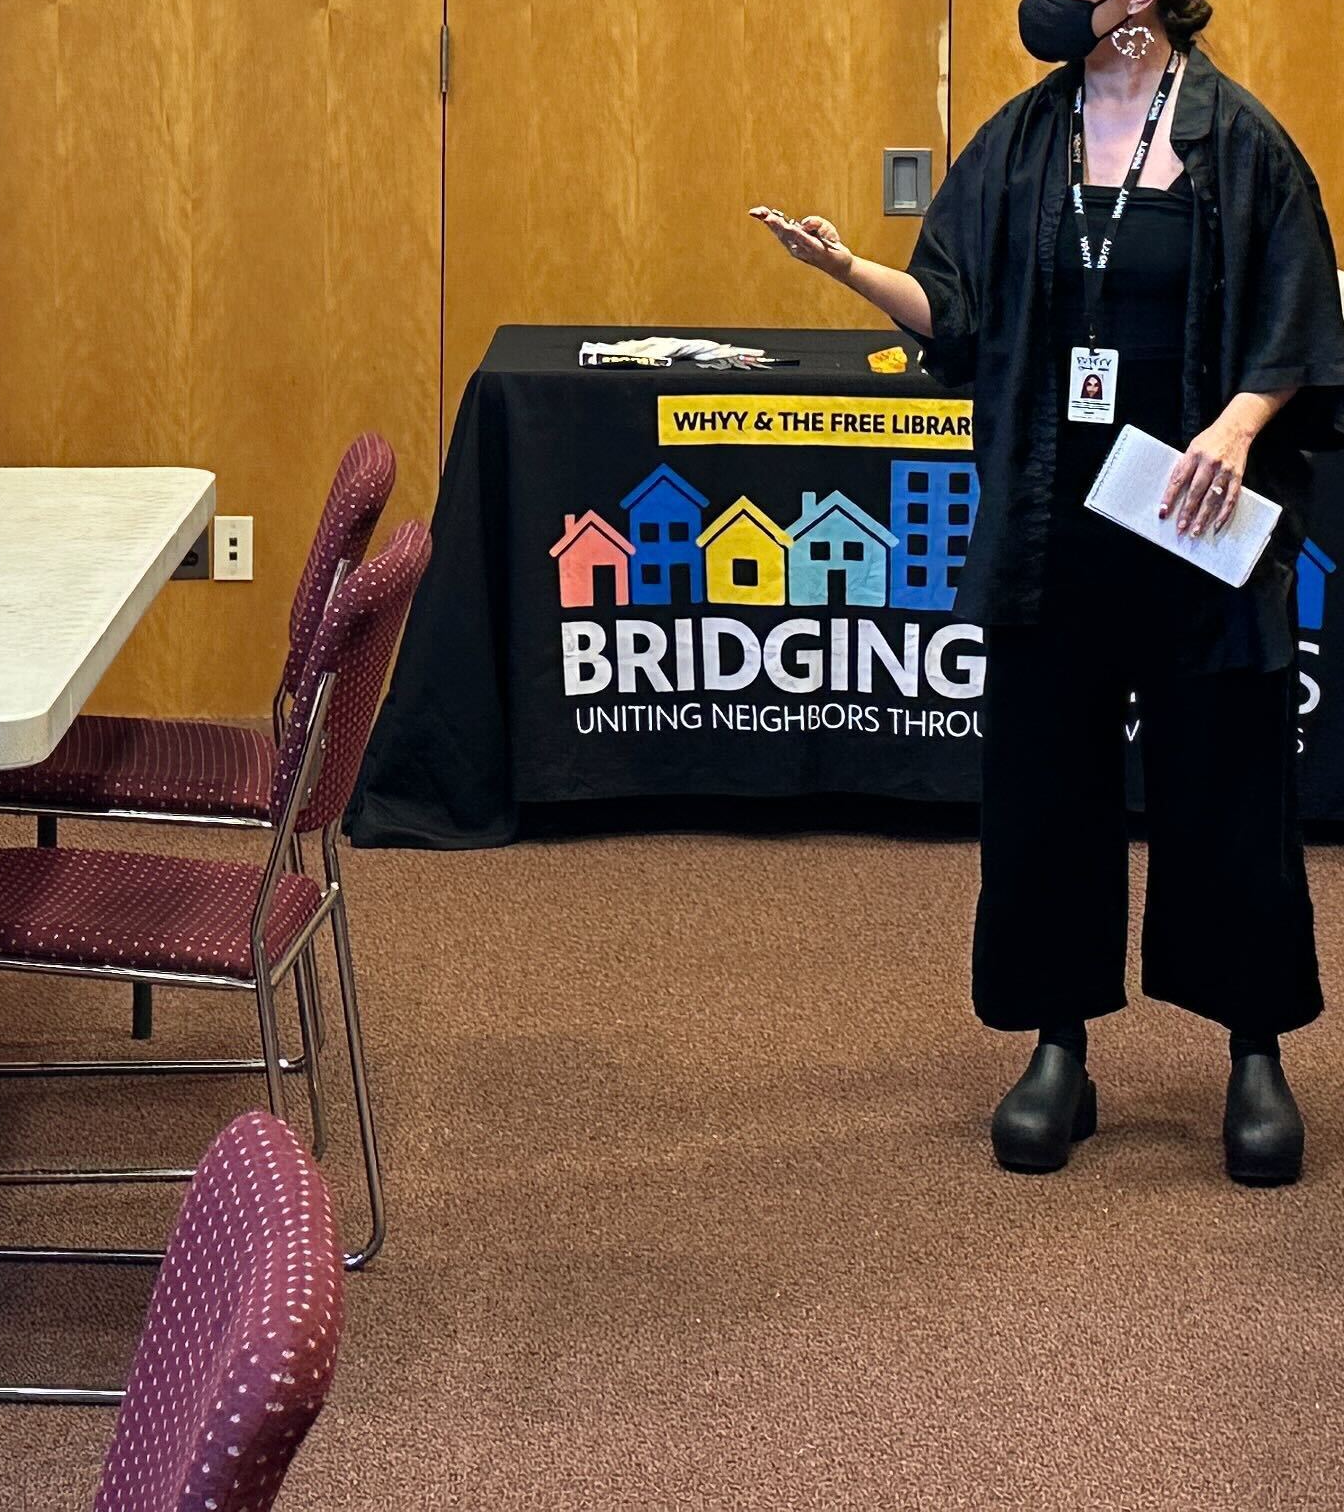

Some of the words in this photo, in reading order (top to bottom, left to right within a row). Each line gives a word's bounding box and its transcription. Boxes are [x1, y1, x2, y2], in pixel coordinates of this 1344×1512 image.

[672, 411, 749, 432] WHYY
[753, 411, 774, 432] &
[778, 411, 825, 432] THE
[830, 413, 886, 434] FREE
[891, 414, 972, 436] LIBRAR
[561, 617, 988, 700] BRIDGING
[575, 703, 702, 734] UNITING
[711, 703, 880, 733] NEIGHBORS
